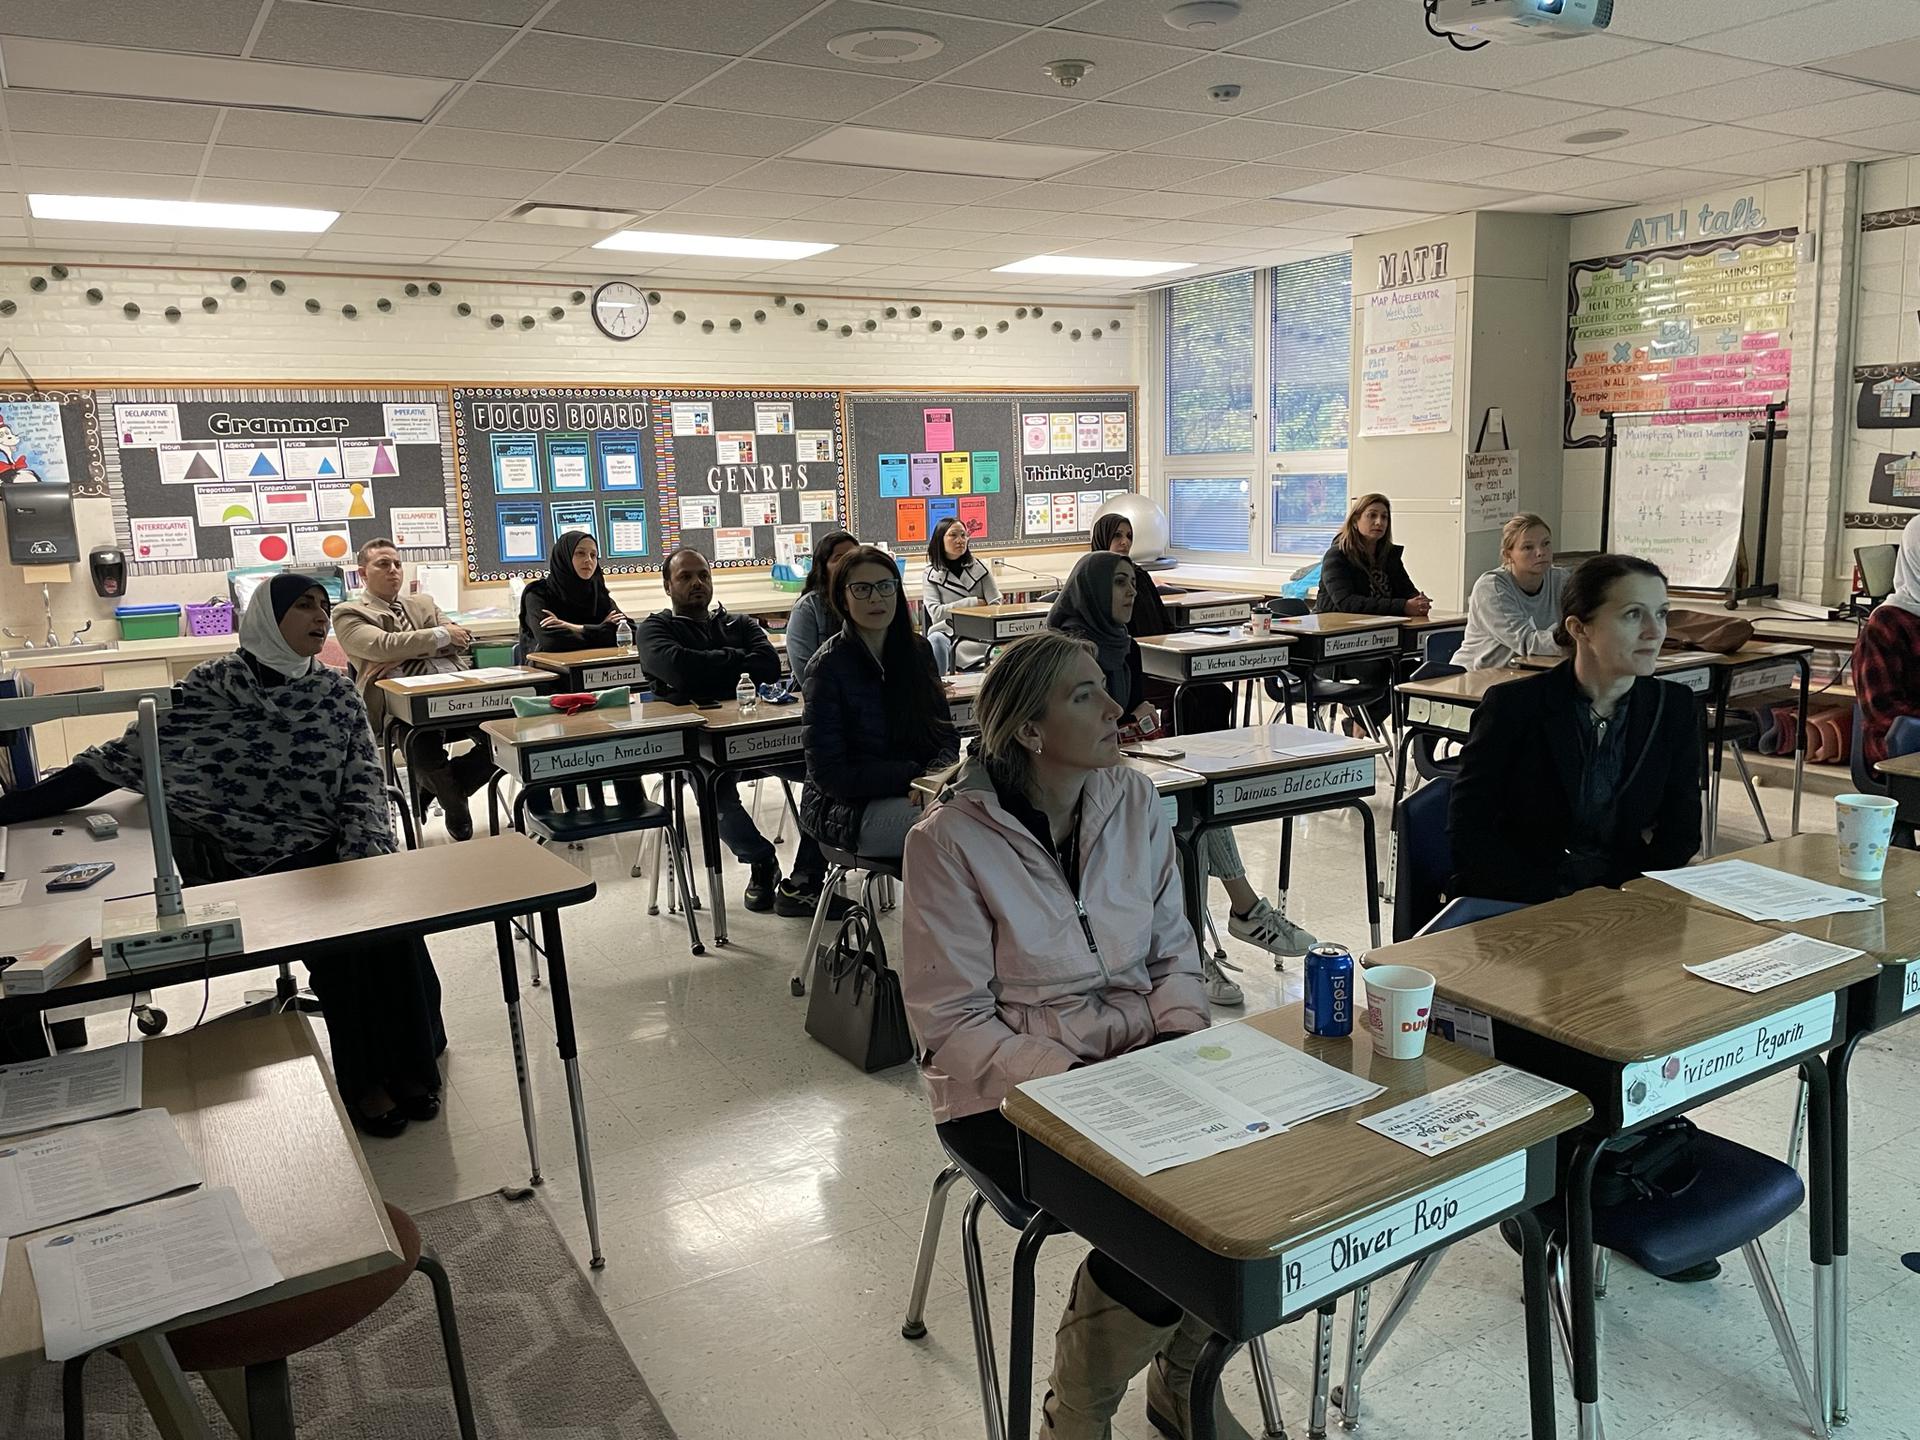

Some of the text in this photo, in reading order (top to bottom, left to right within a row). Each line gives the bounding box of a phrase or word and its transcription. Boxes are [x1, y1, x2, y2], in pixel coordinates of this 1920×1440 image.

[1626, 196, 1766, 249] ATH talk
[1377, 242, 1448, 289] MATH
[1724, 265, 1759, 278] MINUS
[1605, 285, 1624, 295] BOTH
[1578, 327, 1615, 338] increase
[1600, 364, 1622, 375] TIMES
[1613, 378, 1626, 387] ALL
[1576, 392, 1609, 403] multiple
[477, 407, 643, 425] FOCUS BOARD
[208, 412, 350, 435] Grammar
[1626, 429, 1743, 443] Multiplying Mixed Numbers
[1468, 454, 1508, 467] Whether you
[707, 464, 809, 493] GENRES
[1024, 463, 1133, 484] Thinking Maps
[1467, 467, 1512, 480] think you can
[137, 522, 188, 531] INTERROGATIVE
[1008, 622, 1035, 633] Evelyn
[1332, 638, 1368, 651] Alexander
[1207, 658, 1236, 670] Victoria
[601, 669, 637, 681] Michael
[448, 699, 473, 711] Sara
[551, 751, 605, 770] Madelyn
[614, 741, 663, 760] Amedio
[1215, 789, 1224, 806] 3
[1331, 975, 1348, 1023] pepsi
[1683, 1045, 1745, 1084] ivienne
[1201, 1123, 1229, 1138] TIPS
[91, 1233, 124, 1246] TIPS
[1285, 1196, 1458, 1293] 19. Oliver Rojo
